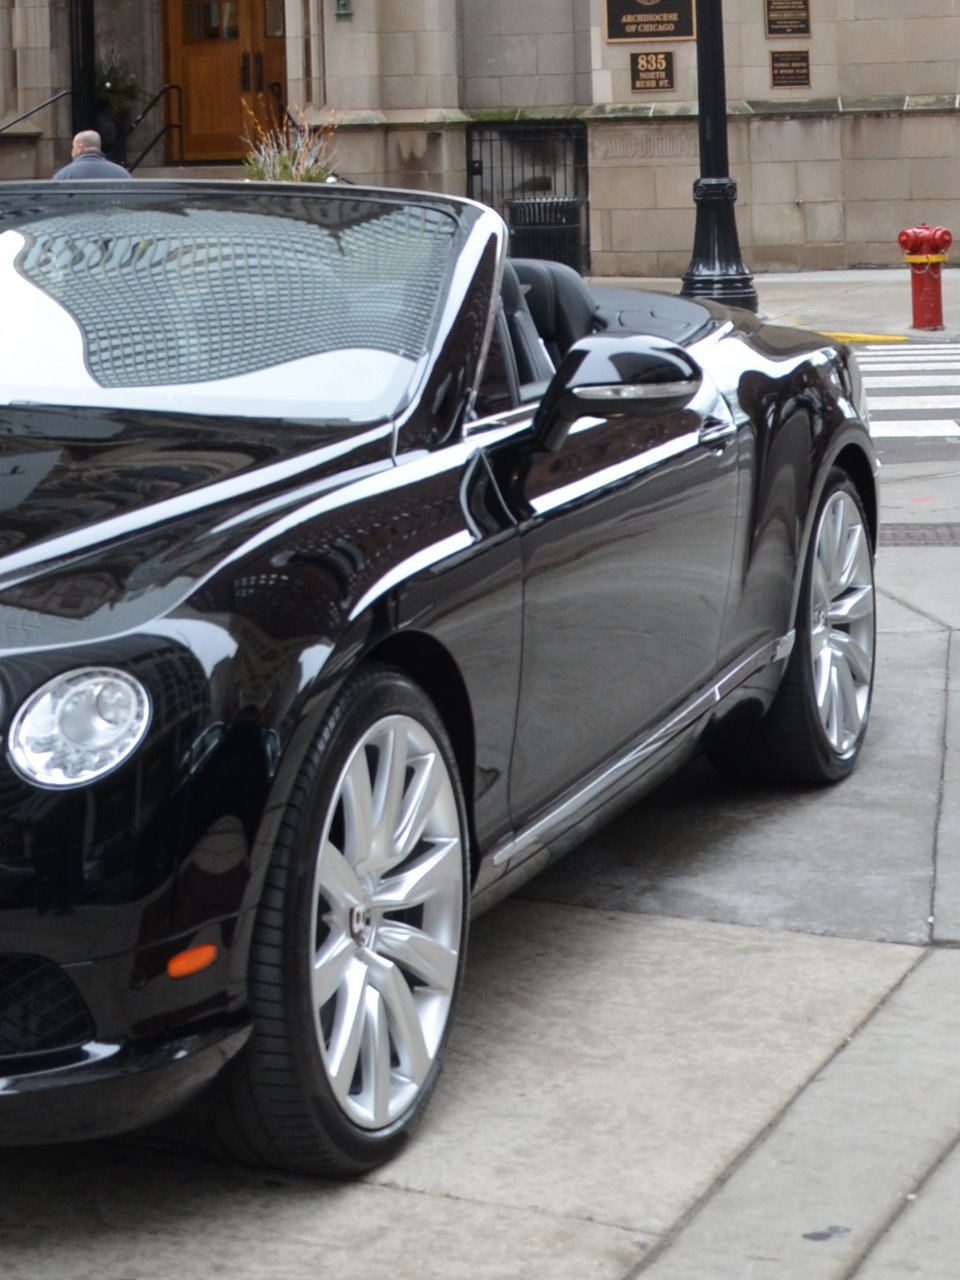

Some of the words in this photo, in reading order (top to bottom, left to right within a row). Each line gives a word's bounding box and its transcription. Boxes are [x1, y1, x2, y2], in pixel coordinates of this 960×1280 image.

[621, 12, 679, 23] ARCHDIOCESE
[625, 24, 637, 33] OF
[638, 23, 675, 32] CHICAGO
[637, 54, 667, 71] 835
[639, 71, 666, 79] NORTH
